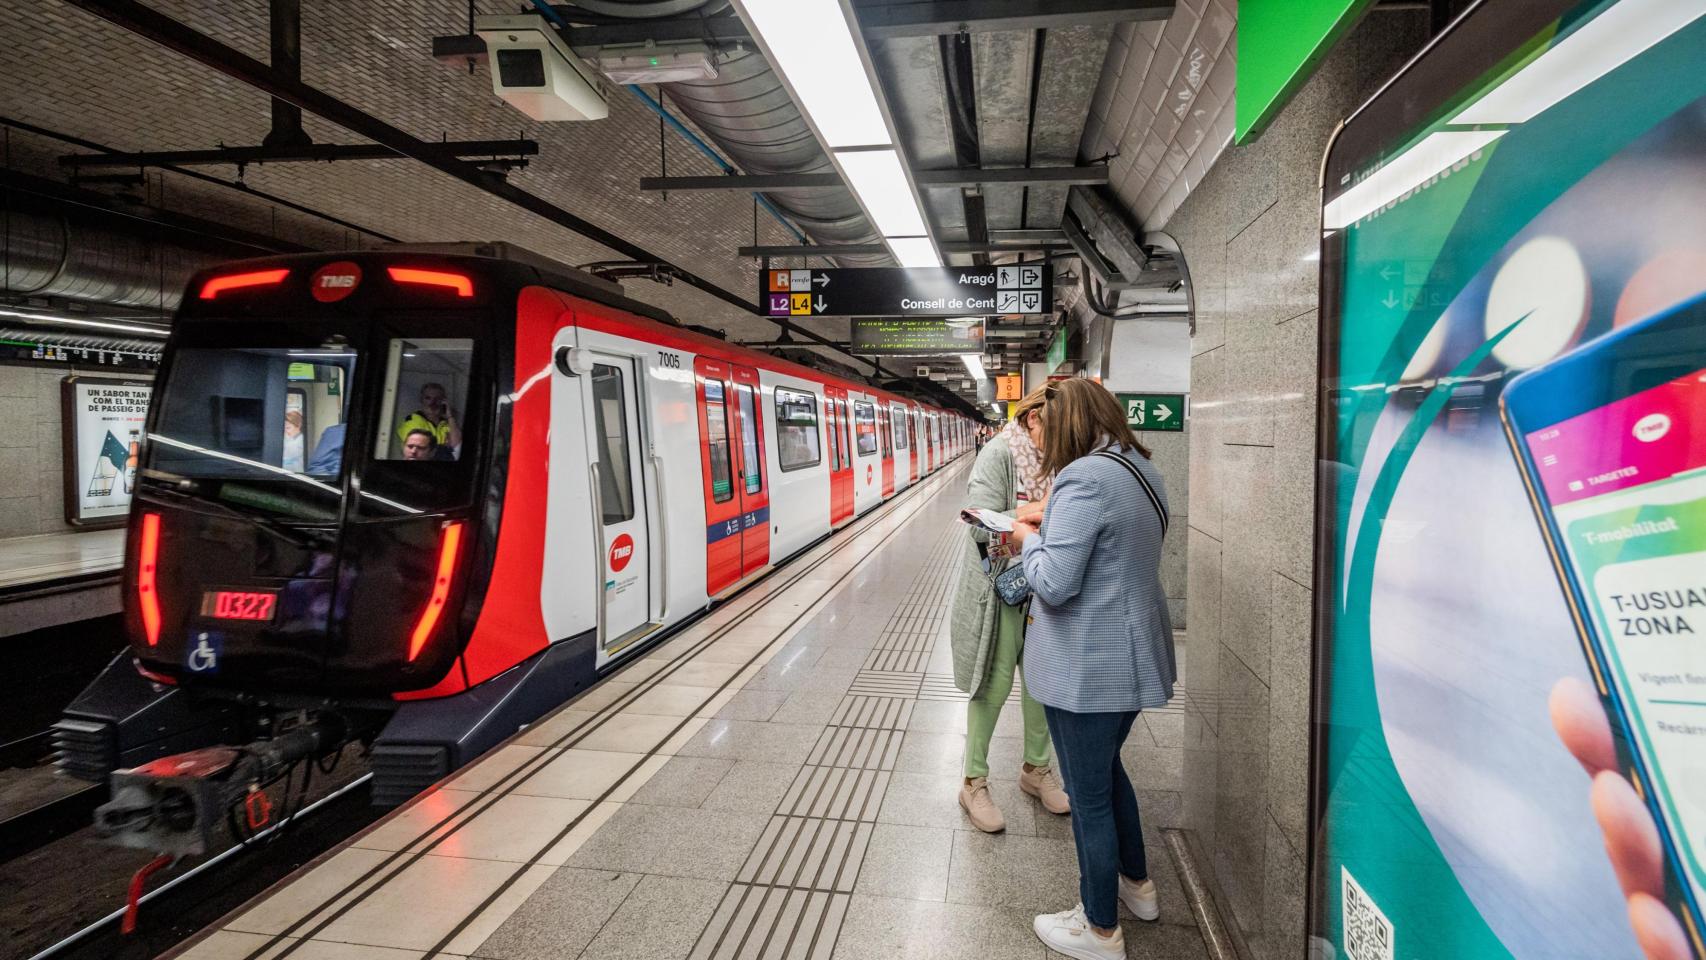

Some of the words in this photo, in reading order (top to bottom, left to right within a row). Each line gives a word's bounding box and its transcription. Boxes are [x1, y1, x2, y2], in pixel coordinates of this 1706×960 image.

[320, 275, 356, 288] TMB
[777, 272, 789, 287] R
[959, 273, 995, 286] Aragó
[771, 298, 789, 311] L2
[792, 298, 809, 311] L4
[901, 298, 945, 310] Consell
[948, 298, 963, 309] de
[966, 297, 995, 309] Cent
[658, 351, 680, 369] 7005
[87, 389, 100, 397] UN
[102, 389, 130, 398] SABOR
[132, 391, 147, 399] TAN
[93, 397, 113, 405] COM
[88, 404, 99, 412] DE
[101, 404, 134, 413] PASSEIG
[1582, 516, 1680, 545] T-mobilitat
[614, 545, 632, 561] TMB
[215, 592, 277, 619] 0327
[1619, 615, 1695, 637] ZONA
